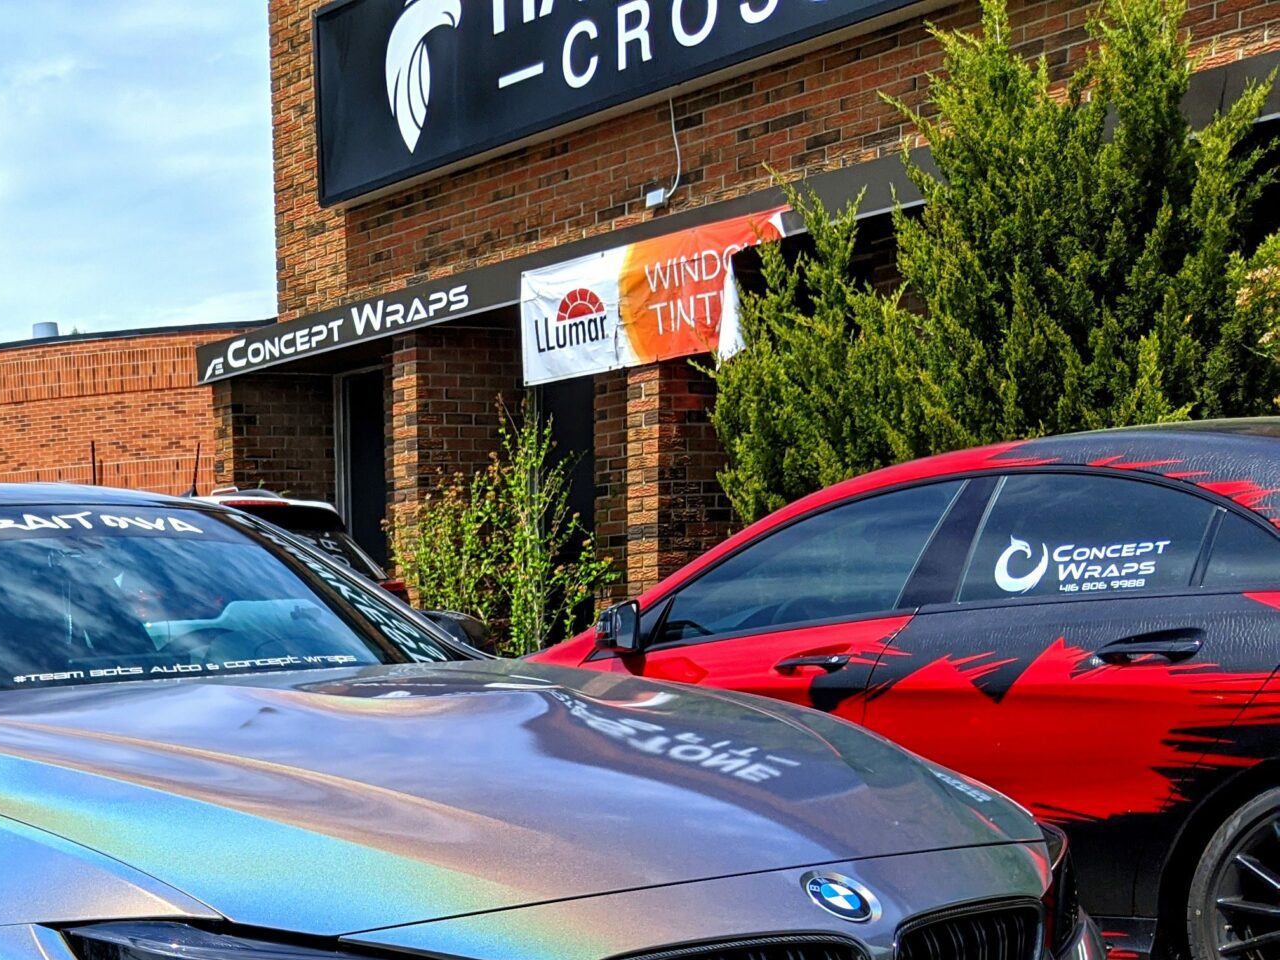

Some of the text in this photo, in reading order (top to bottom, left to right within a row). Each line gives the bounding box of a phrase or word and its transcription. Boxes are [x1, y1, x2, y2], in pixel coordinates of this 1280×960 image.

[1059, 578, 1145, 592] 416 806 9988
[206, 663, 219, 671] &
